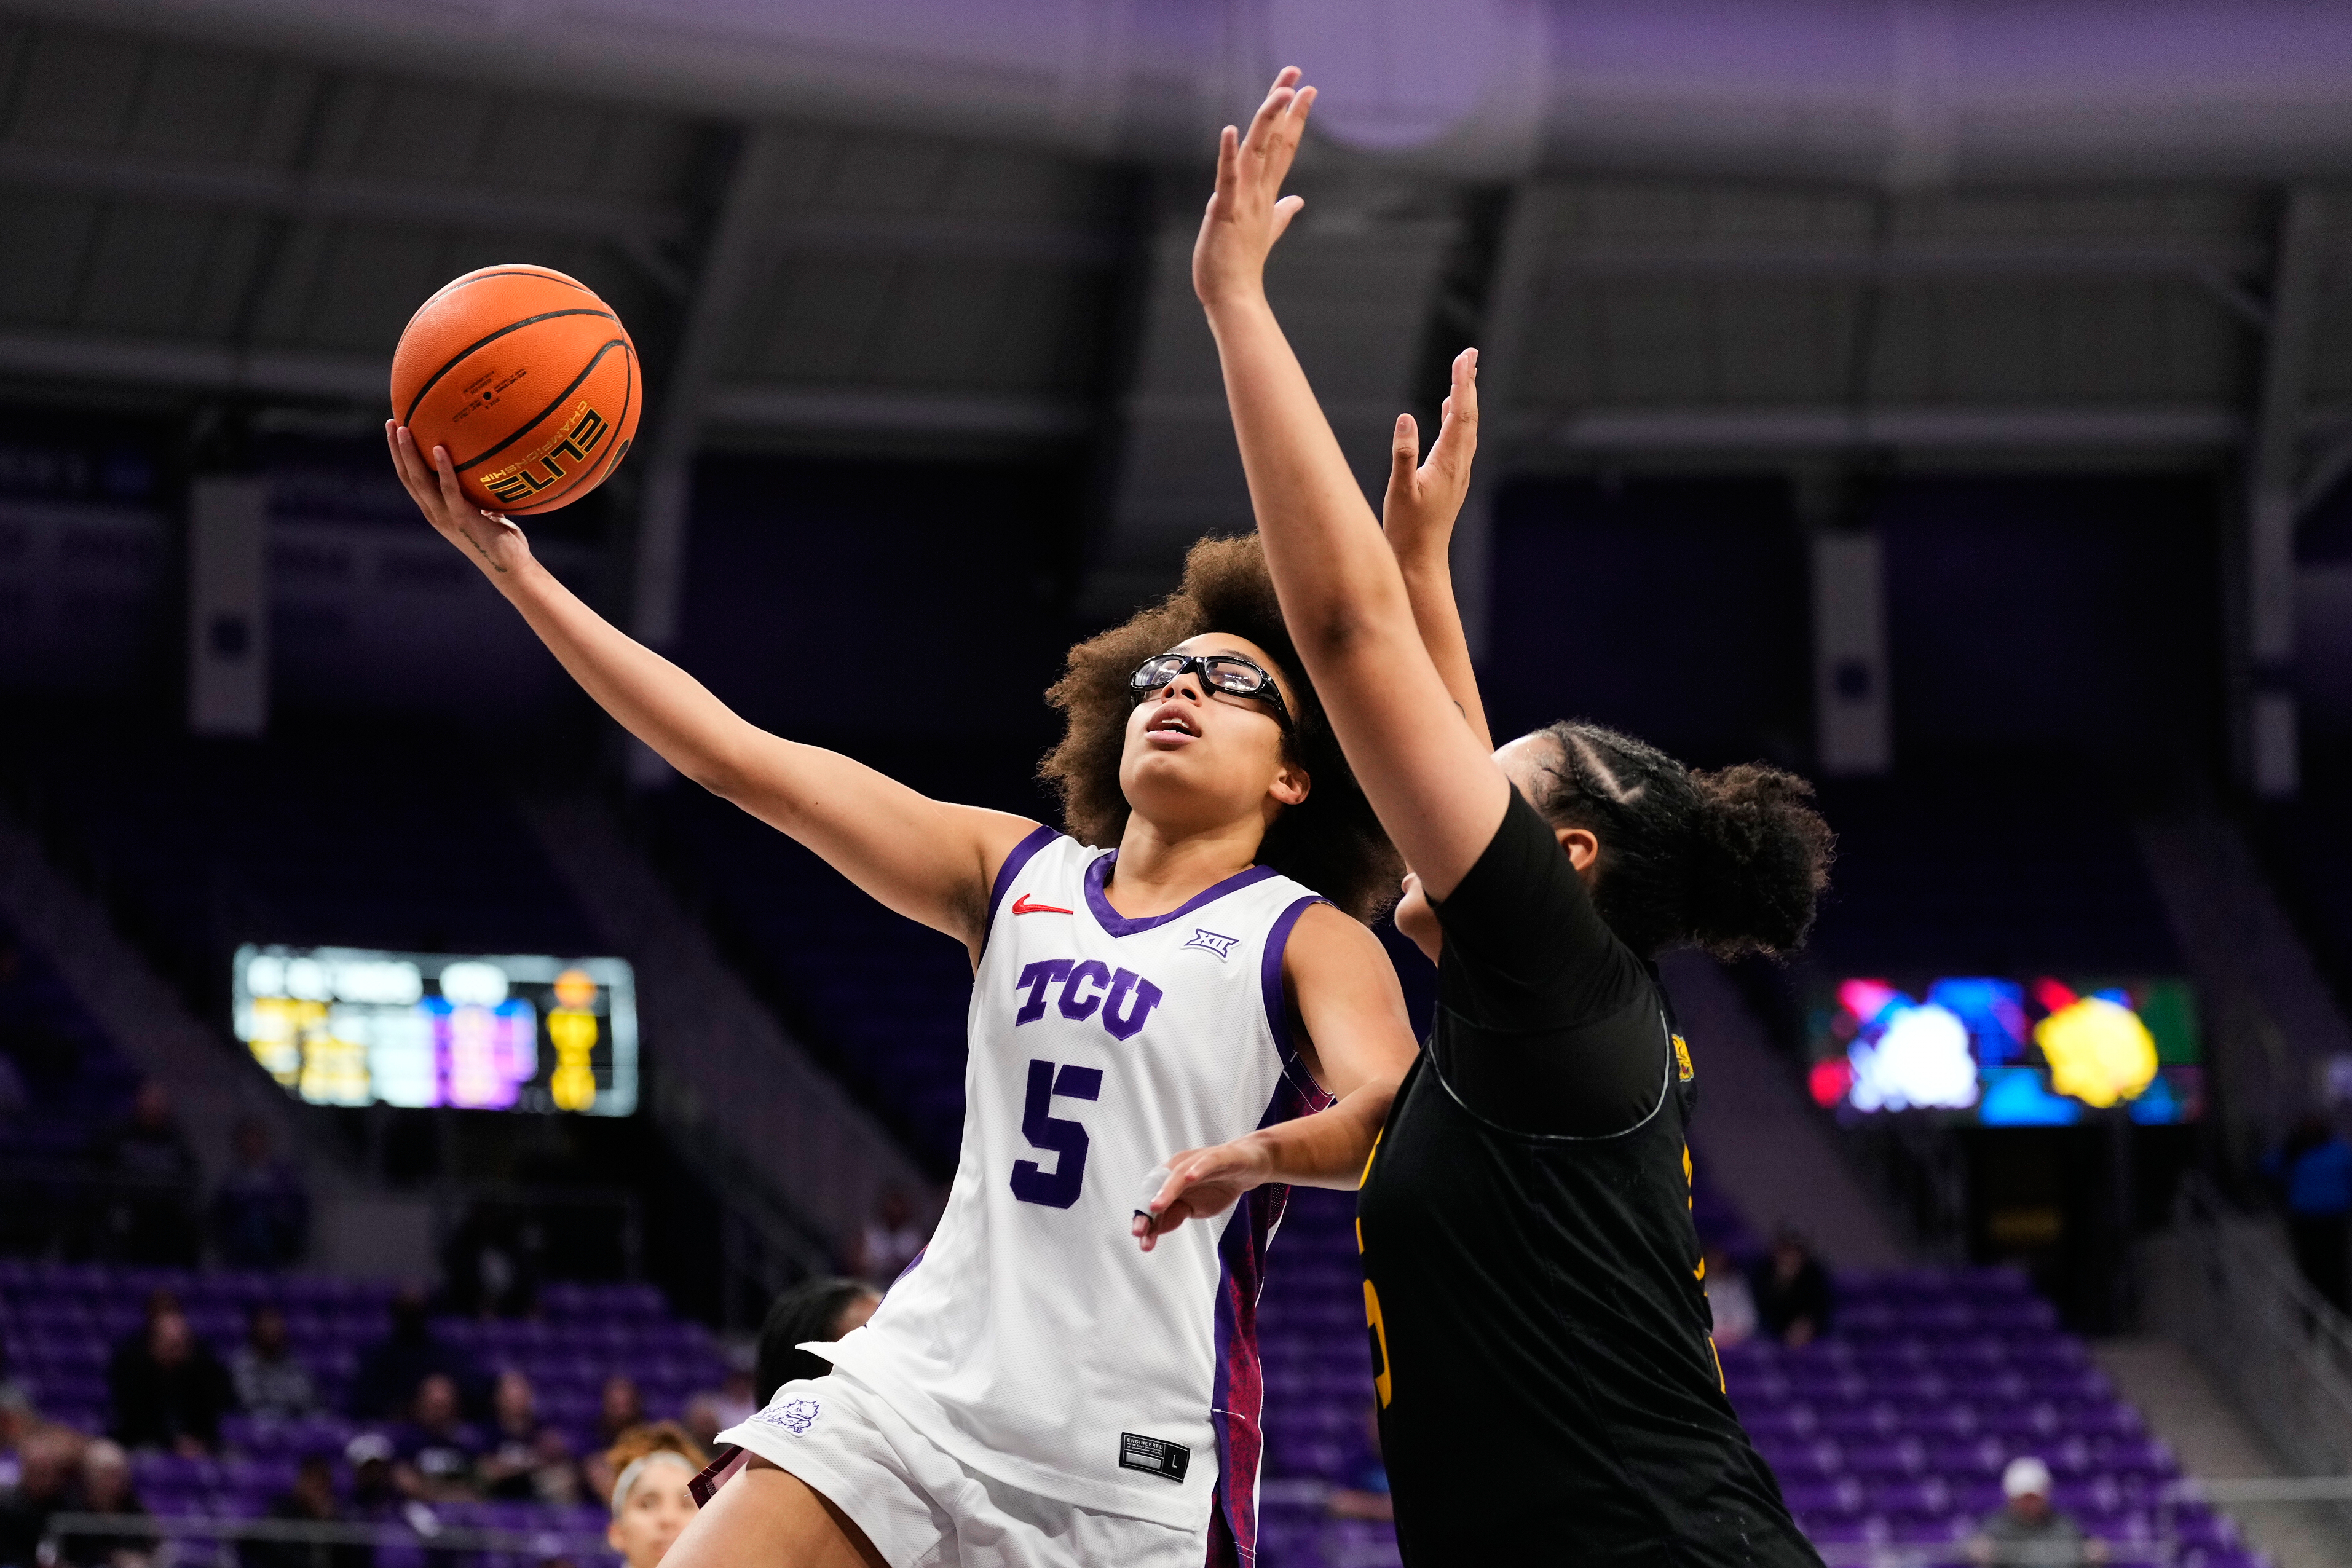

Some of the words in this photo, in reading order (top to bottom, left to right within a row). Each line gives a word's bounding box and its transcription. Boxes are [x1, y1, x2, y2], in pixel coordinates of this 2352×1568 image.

[480, 400, 588, 483] CHAMPIONSHIP
[484, 407, 610, 503] ELITE
[1016, 959, 1163, 1041] TCU
[1010, 1058, 1103, 1209] 5
[1127, 1438, 1163, 1449] ENGINEERED
[1172, 1454, 1177, 1469] L
